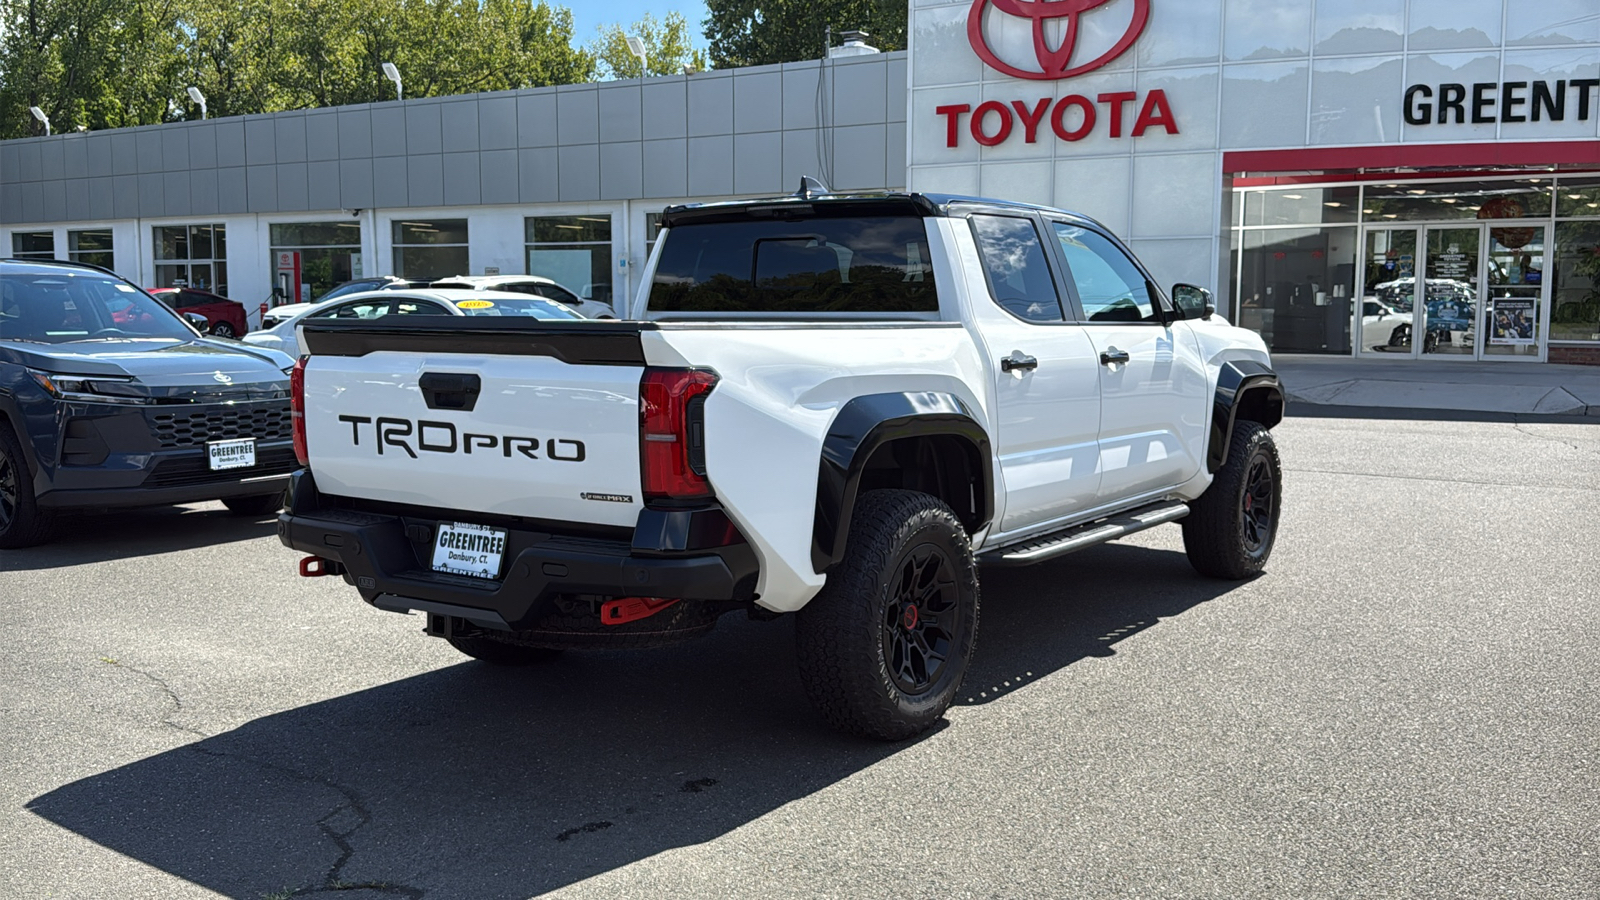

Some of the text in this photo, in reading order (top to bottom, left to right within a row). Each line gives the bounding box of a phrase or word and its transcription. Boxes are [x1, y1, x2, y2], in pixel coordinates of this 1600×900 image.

[1403, 79, 1600, 126] GREENT
[936, 89, 1180, 148] TOYOTA
[211, 444, 253, 457] GREENTREE
[440, 531, 503, 555] GREENTREE
[448, 551, 488, 564] Danbury, CT.
